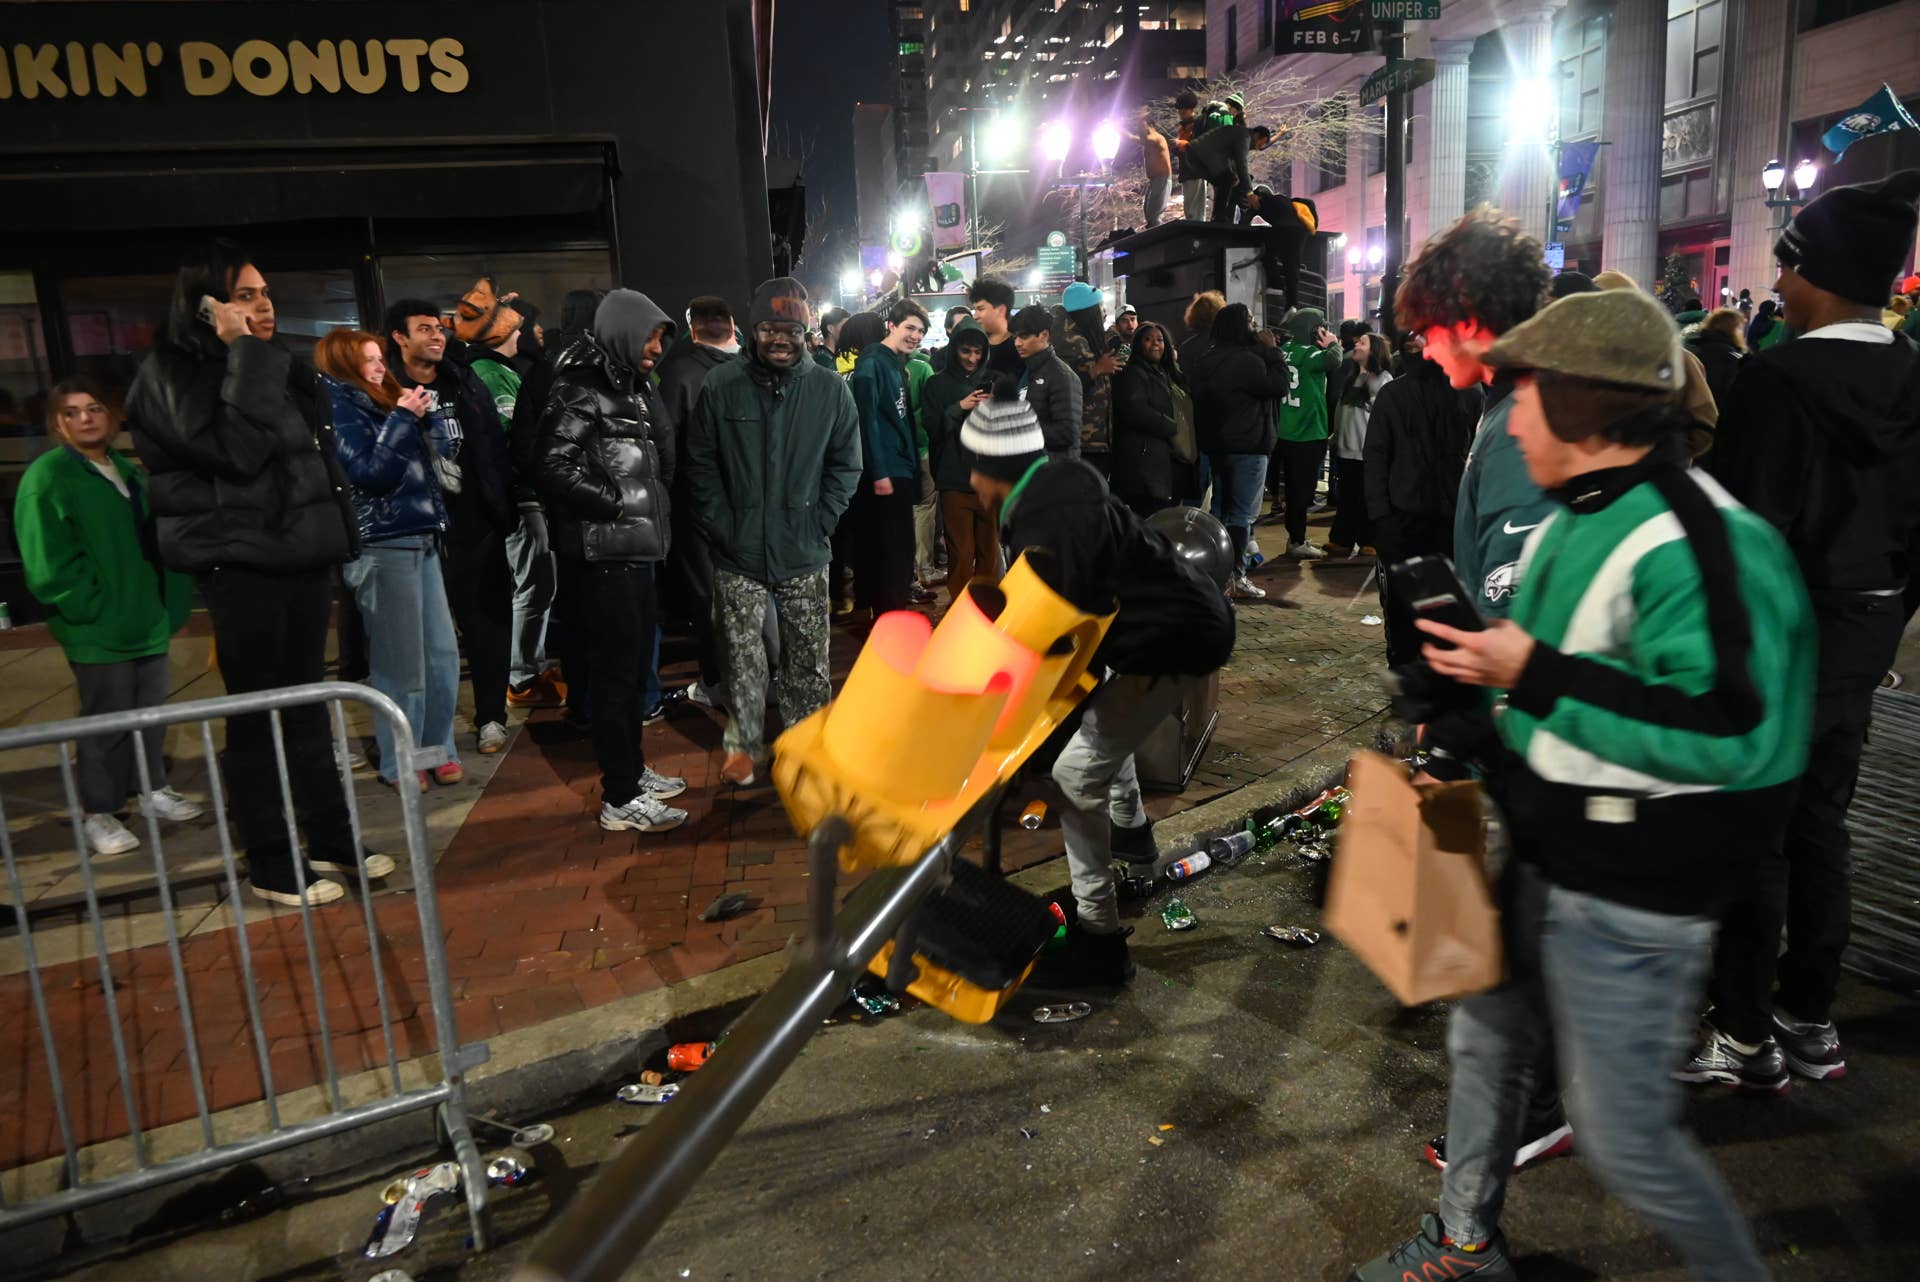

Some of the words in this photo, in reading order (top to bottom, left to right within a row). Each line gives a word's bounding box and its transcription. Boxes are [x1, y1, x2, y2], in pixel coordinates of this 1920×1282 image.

[1371, 2, 1423, 19] UNIPER
[1428, 7, 1440, 19] ST
[1293, 31, 1327, 45] FEB
[0, 41, 164, 100] KIN'
[179, 38, 470, 97] DONUTS
[1361, 70, 1399, 105] MARKET
[1403, 68, 1413, 82] ST
